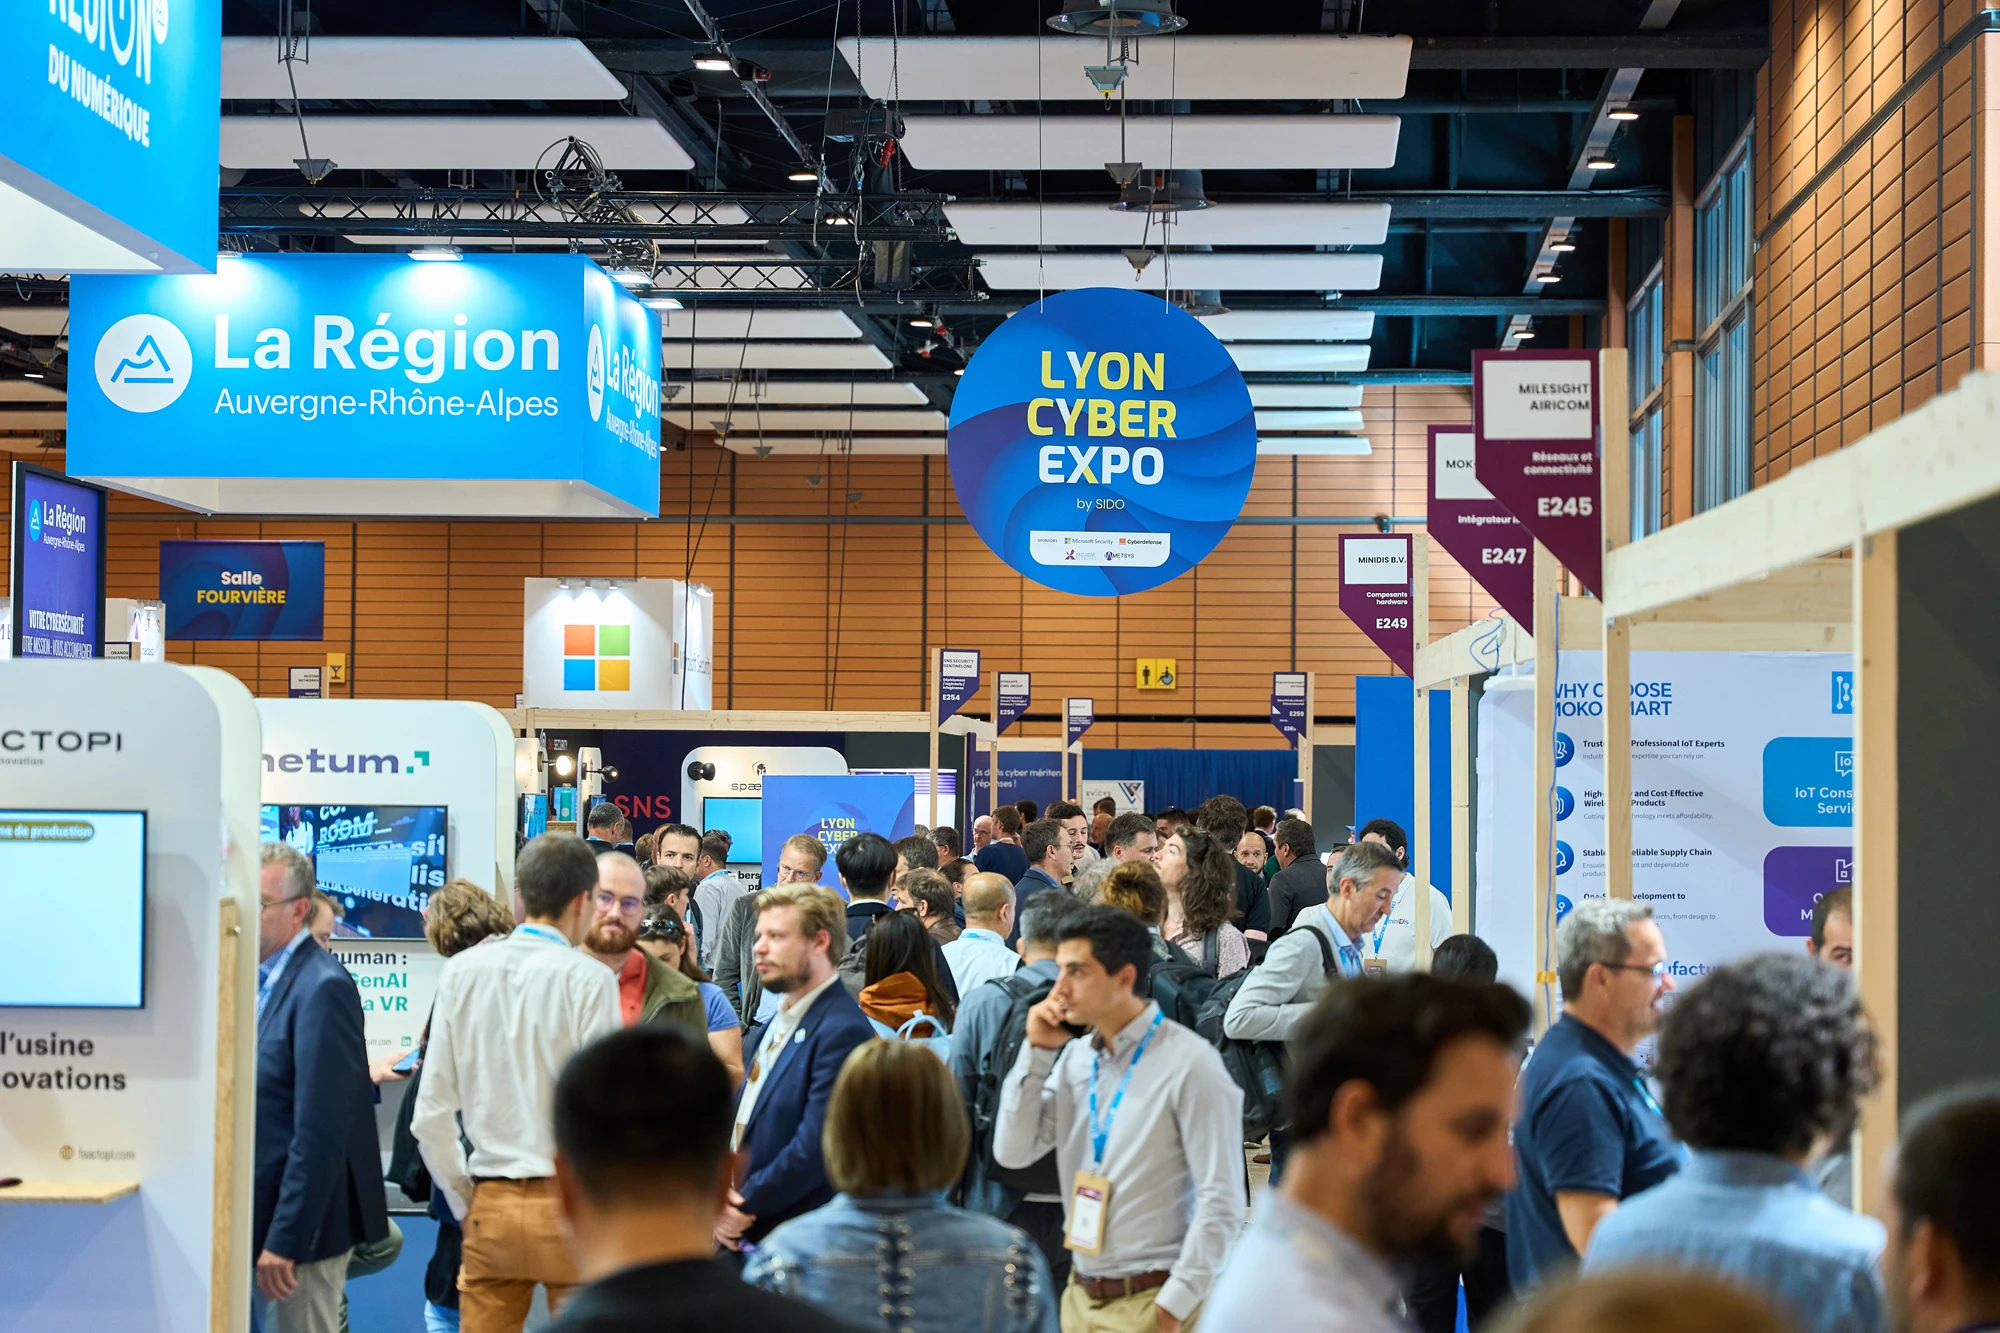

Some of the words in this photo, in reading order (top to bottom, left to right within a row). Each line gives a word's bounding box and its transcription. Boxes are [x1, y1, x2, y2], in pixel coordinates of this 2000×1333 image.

[48, 43, 70, 92] DU
[71, 59, 150, 148] NUMÉRIQUE
[214, 313, 291, 369] La
[313, 312, 560, 384] Région
[606, 332, 620, 392] La
[621, 343, 659, 420] Région
[1041, 350, 1165, 391] LYON
[1518, 383, 1590, 394] MILESIGHT
[214, 387, 559, 422] Auvergne-Rhône-Alpes
[1529, 399, 1590, 410] AIRICOM
[1027, 397, 1177, 439] CYBER
[605, 405, 658, 461] Auvergne-Rhône-Alpes
[1532, 450, 1580, 463] Réseaux
[1580, 451, 1593, 463] et
[1038, 445, 1165, 486] EXPO
[1446, 459, 1475, 469] MOK
[1523, 463, 1593, 476] connectivité
[1076, 498, 1092, 513] by
[1095, 498, 1125, 510] SIDO
[1537, 496, 1593, 517] E245
[43, 500, 54, 527] La
[55, 503, 86, 537] Région
[1458, 514, 1512, 527] Intégrateur
[1127, 538, 1162, 546] Cyberdefense
[1358, 556, 1389, 564] MINIDIS
[1391, 556, 1406, 564] B.V.
[1481, 547, 1527, 565] E247
[221, 570, 263, 586] Salle
[196, 586, 286, 604] FOURVIÈRE
[1366, 591, 1408, 600] Composants
[1376, 617, 1408, 629] E249
[22, 635, 33, 653] OTRE
[1593, 682, 1673, 699] COSE
[1629, 700, 1673, 716] ART
[1, 729, 122, 753] CTOPI
[1583, 739, 1604, 748] Trust
[1631, 739, 1680, 748] Professional
[1681, 739, 1694, 748] IoT
[1695, 739, 1725, 750] Experts
[1631, 753, 1658, 761] expertise
[1683, 753, 1695, 761] rely
[1840, 755, 1854, 767] Io
[1005, 768, 1028, 778] cyber
[730, 783, 762, 792] spæ
[1584, 790, 1605, 799] High-
[1650, 789, 1704, 797] Cost-Effective
[1795, 787, 1816, 799] IoT
[1819, 787, 1854, 799] Cons
[614, 794, 672, 819] SNS
[1583, 799, 1605, 807] Wirel
[1631, 799, 1666, 807] Products
[821, 817, 855, 829] LYON
[1631, 812, 1656, 821] hnology
[1675, 812, 1713, 821] affordability.
[821, 843, 843, 855] EX
[1631, 848, 1658, 857] eliable
[1660, 848, 1687, 859] Supply
[1689, 848, 1712, 857] Chain
[1582, 861, 1606, 869] Ensurin
[1653, 861, 1689, 870] dependable
[1582, 870, 1606, 879] product
[1632, 892, 1676, 902] velopment
[1677, 893, 1686, 901] to
[1655, 913, 1672, 921] vices,
[1688, 913, 1709, 922] design
[360, 995, 374, 1011] a
[379, 995, 408, 1012] VR
[0, 1031, 94, 1057] l'usine
